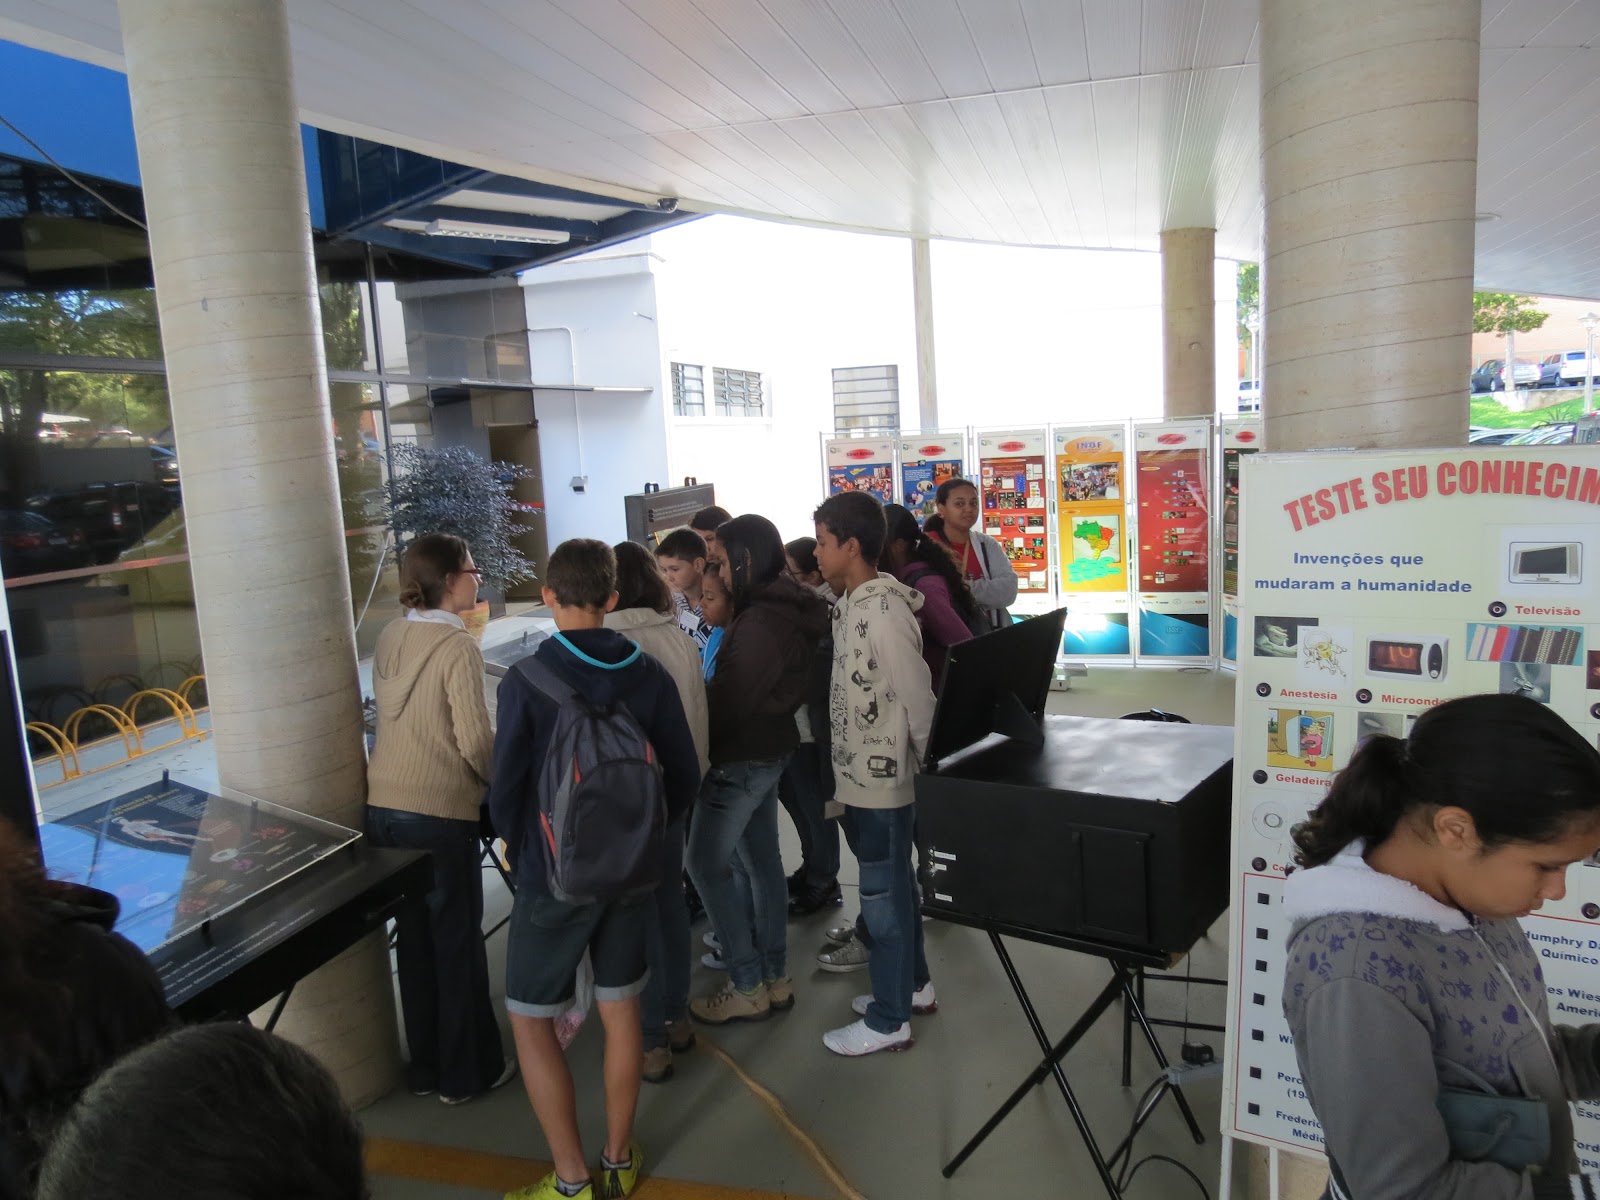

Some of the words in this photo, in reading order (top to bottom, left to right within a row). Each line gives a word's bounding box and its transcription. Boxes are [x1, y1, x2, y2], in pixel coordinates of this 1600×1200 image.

[1283, 477, 1369, 532] TESTE
[1372, 465, 1428, 505] SEU
[1293, 552, 1384, 568] Invenções
[1390, 554, 1424, 568] que
[1254, 577, 1335, 590] mudaram
[1340, 580, 1351, 591] a
[1357, 578, 1473, 593] humanidade
[1514, 605, 1581, 617] Televisão
[1279, 688, 1338, 701] Anestesia
[1381, 694, 1446, 706] Microond
[1275, 773, 1332, 787] Geladeira
[1588, 940, 1600, 950] D
[1556, 1002, 1600, 1018] Ameri
